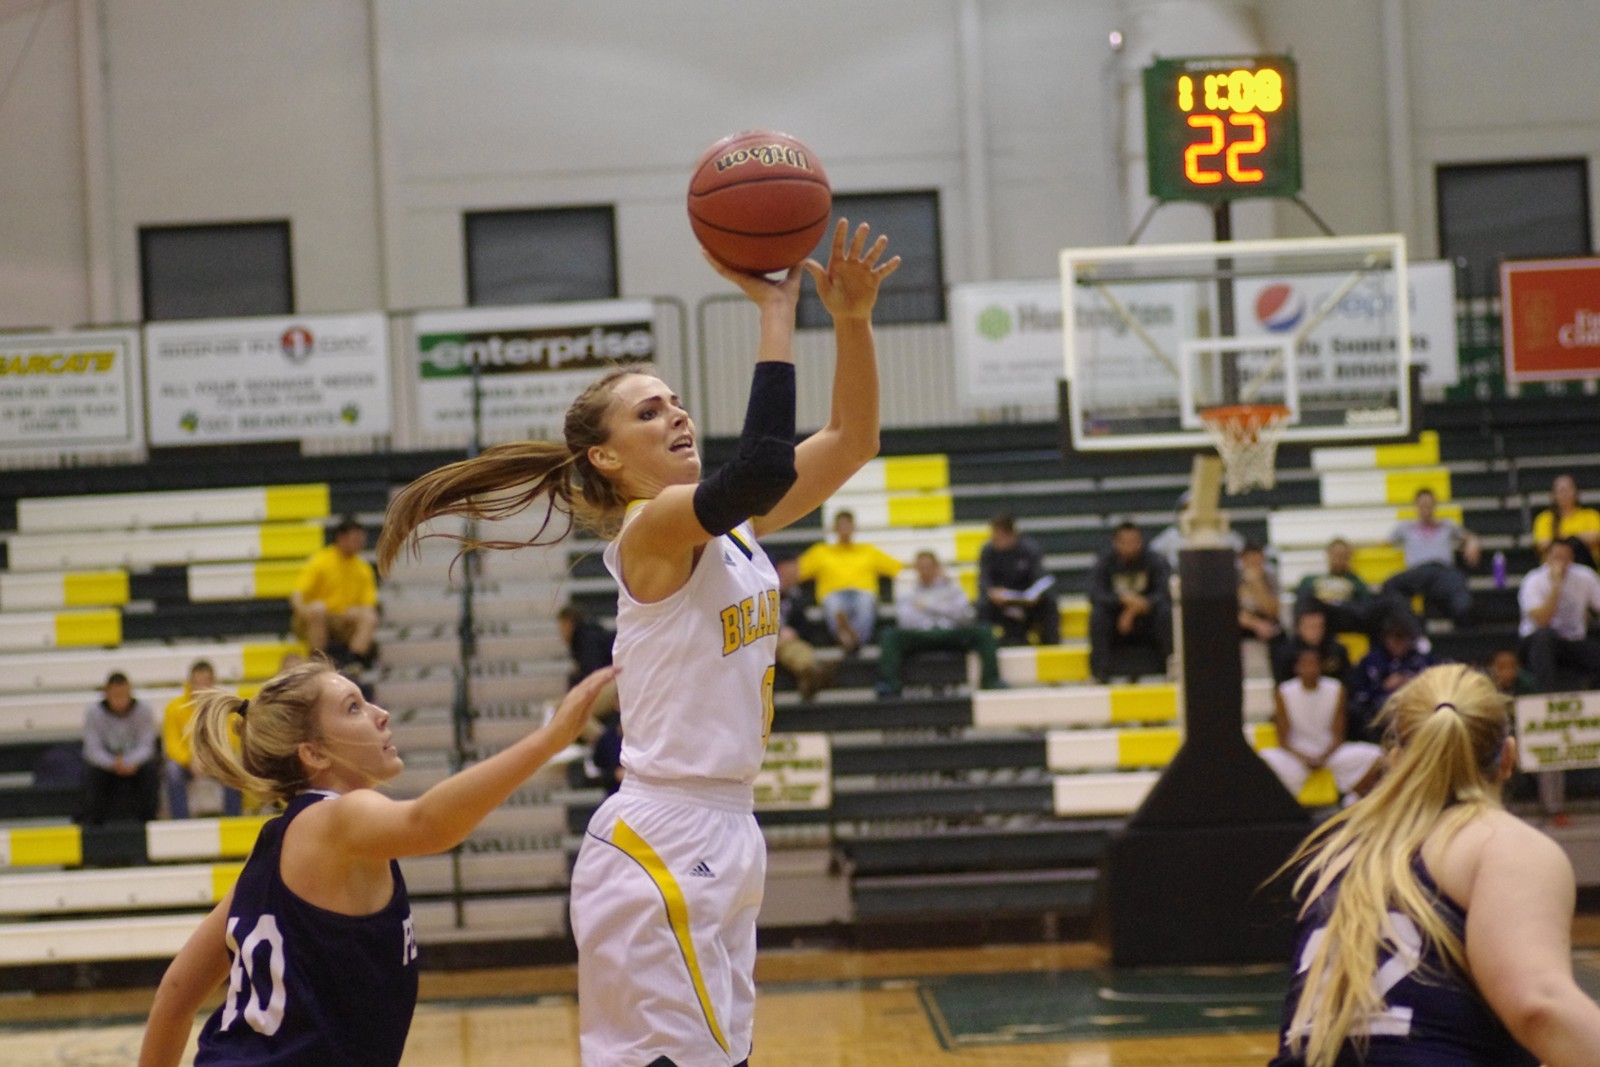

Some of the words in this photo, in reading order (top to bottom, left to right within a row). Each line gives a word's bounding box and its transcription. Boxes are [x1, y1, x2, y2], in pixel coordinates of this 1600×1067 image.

[1178, 68, 1283, 113] 11:08
[714, 143, 814, 172] Wilson
[1184, 112, 1267, 185] 22
[421, 327, 652, 370] enterprise
